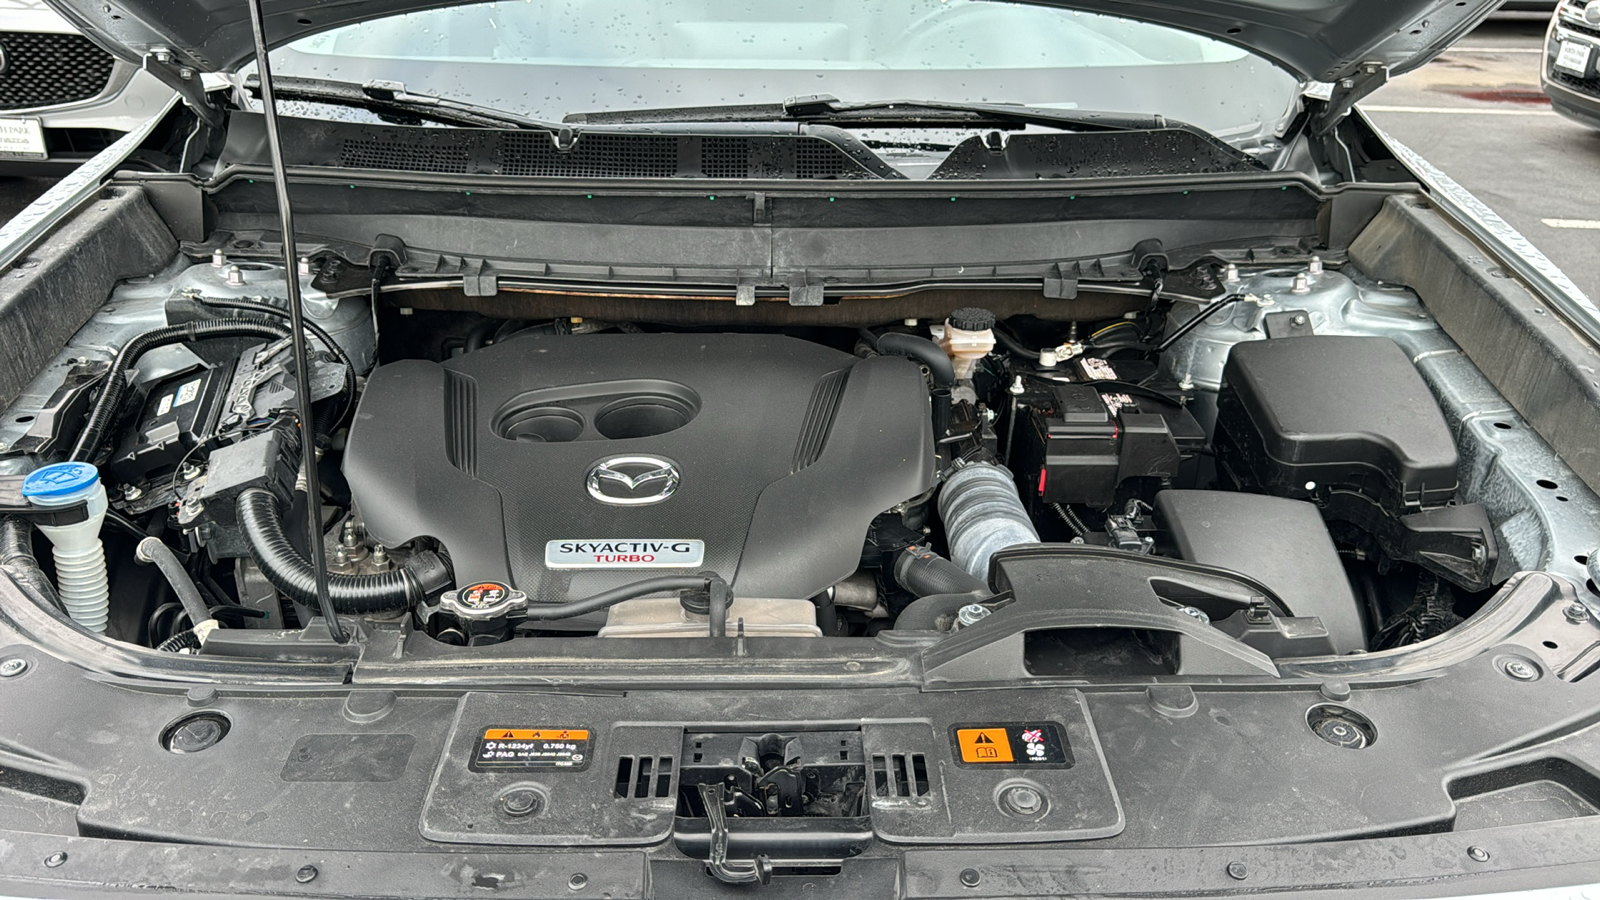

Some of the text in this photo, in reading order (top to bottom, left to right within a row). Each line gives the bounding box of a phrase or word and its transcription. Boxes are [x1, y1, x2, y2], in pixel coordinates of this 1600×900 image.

[559, 542, 691, 554] SKYACTIV-G
[593, 554, 655, 563] TURBO
[498, 743, 534, 751] R-1234yf
[565, 743, 577, 751] kg
